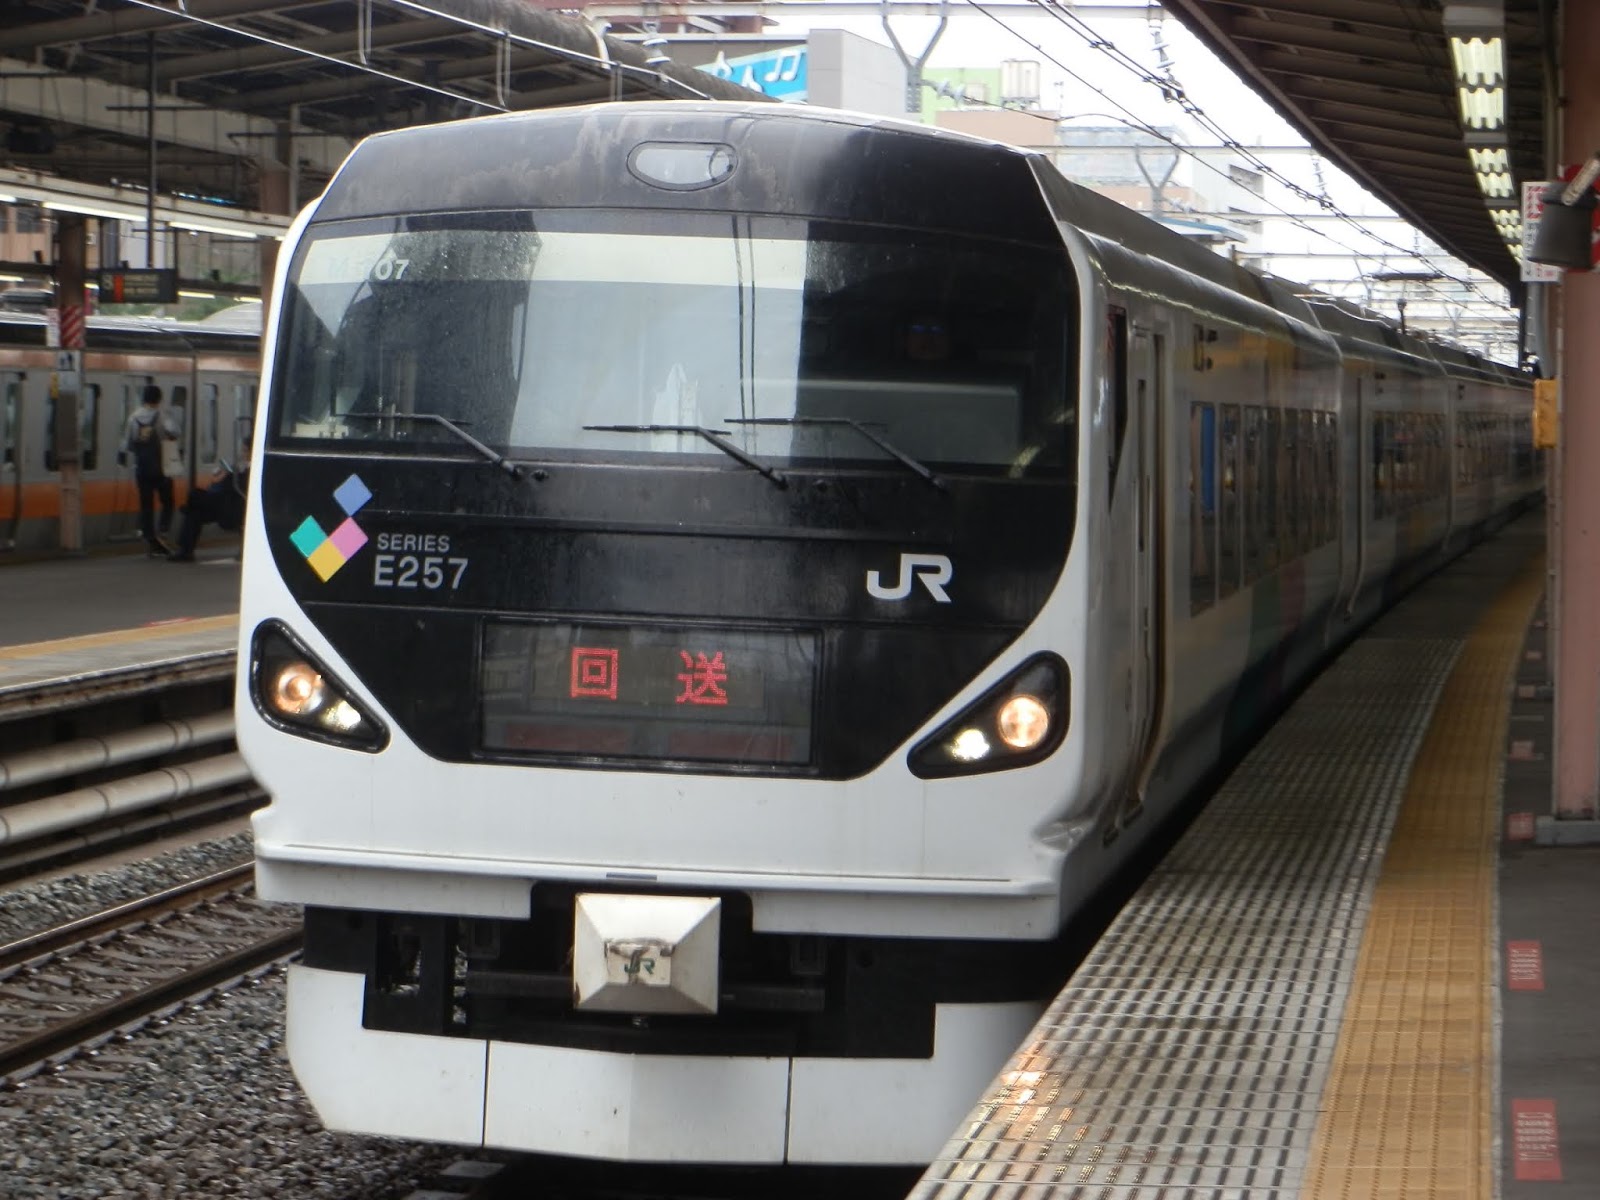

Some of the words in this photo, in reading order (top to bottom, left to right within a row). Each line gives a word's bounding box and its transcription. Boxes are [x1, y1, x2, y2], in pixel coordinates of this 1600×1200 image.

[377, 532, 450, 553] SERIES
[374, 554, 469, 590] E257
[866, 552, 953, 603] JR
[623, 956, 656, 975] JR
